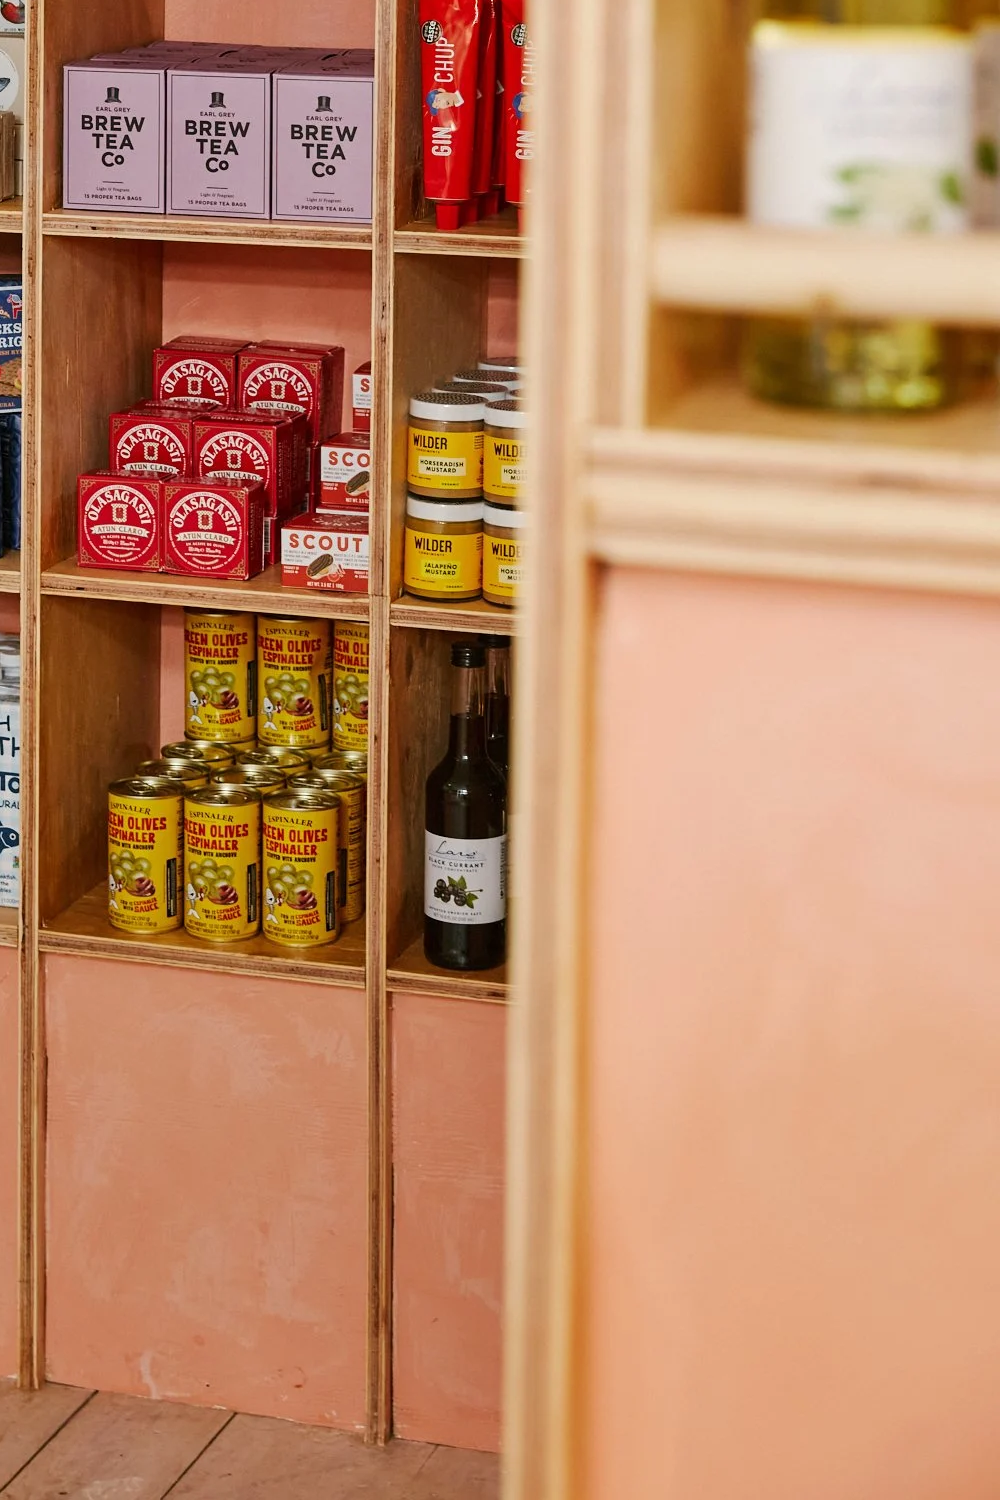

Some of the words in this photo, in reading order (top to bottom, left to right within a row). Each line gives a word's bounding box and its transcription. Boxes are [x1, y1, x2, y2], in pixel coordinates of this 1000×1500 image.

[434, 37, 455, 83] CHUP
[81, 115, 145, 132] BREW
[185, 120, 250, 138] BREW
[290, 125, 357, 142] BREW
[432, 126, 452, 157] GIN
[92, 134, 134, 150] TEA
[196, 139, 239, 156] TEA
[302, 144, 345, 160] TEA
[413, 433, 447, 449] WILDER
[420, 459, 464, 467] HORSERADISH
[86, 491, 152, 525] OLASAGASTI
[172, 496, 237, 532] OLASAGASTI
[119, 526, 143, 535] CLARO
[289, 534, 363, 552] SCOUT
[414, 536, 452, 552] WILDER
[424, 562, 457, 570] JALAPEÑO
[286, 639, 322, 652] OLIVES
[263, 653, 313, 664] ESPINALER
[289, 828, 328, 842] OLIVES
[265, 839, 318, 856] ESPINALER
